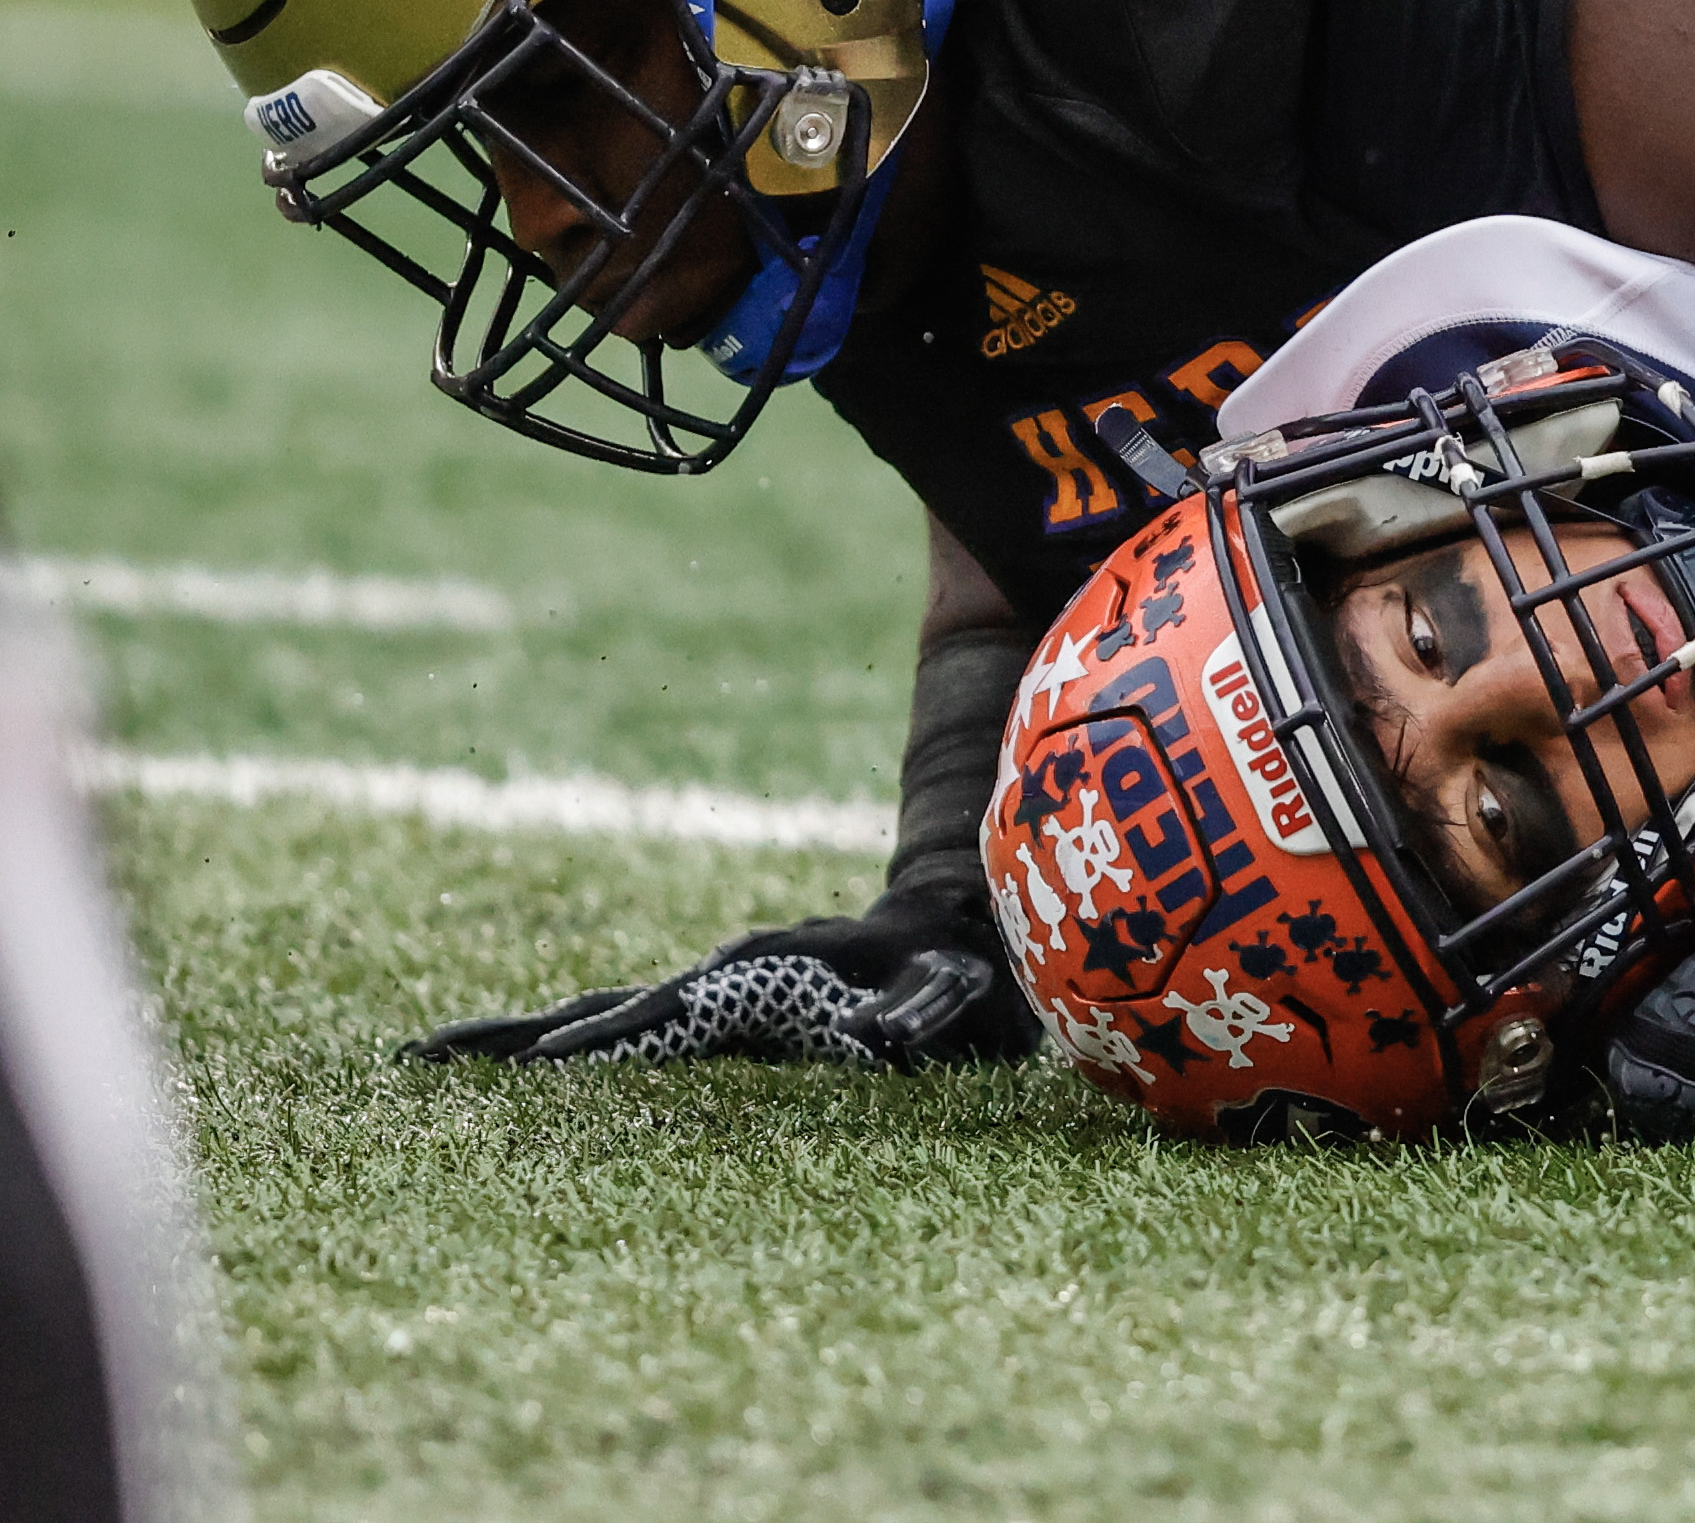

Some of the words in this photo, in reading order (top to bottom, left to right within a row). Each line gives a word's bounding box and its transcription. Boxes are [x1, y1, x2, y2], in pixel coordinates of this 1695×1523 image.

[257, 91, 317, 146] HERO
[983, 291, 1076, 357] adidas
[1209, 660, 1313, 839] Riddell
